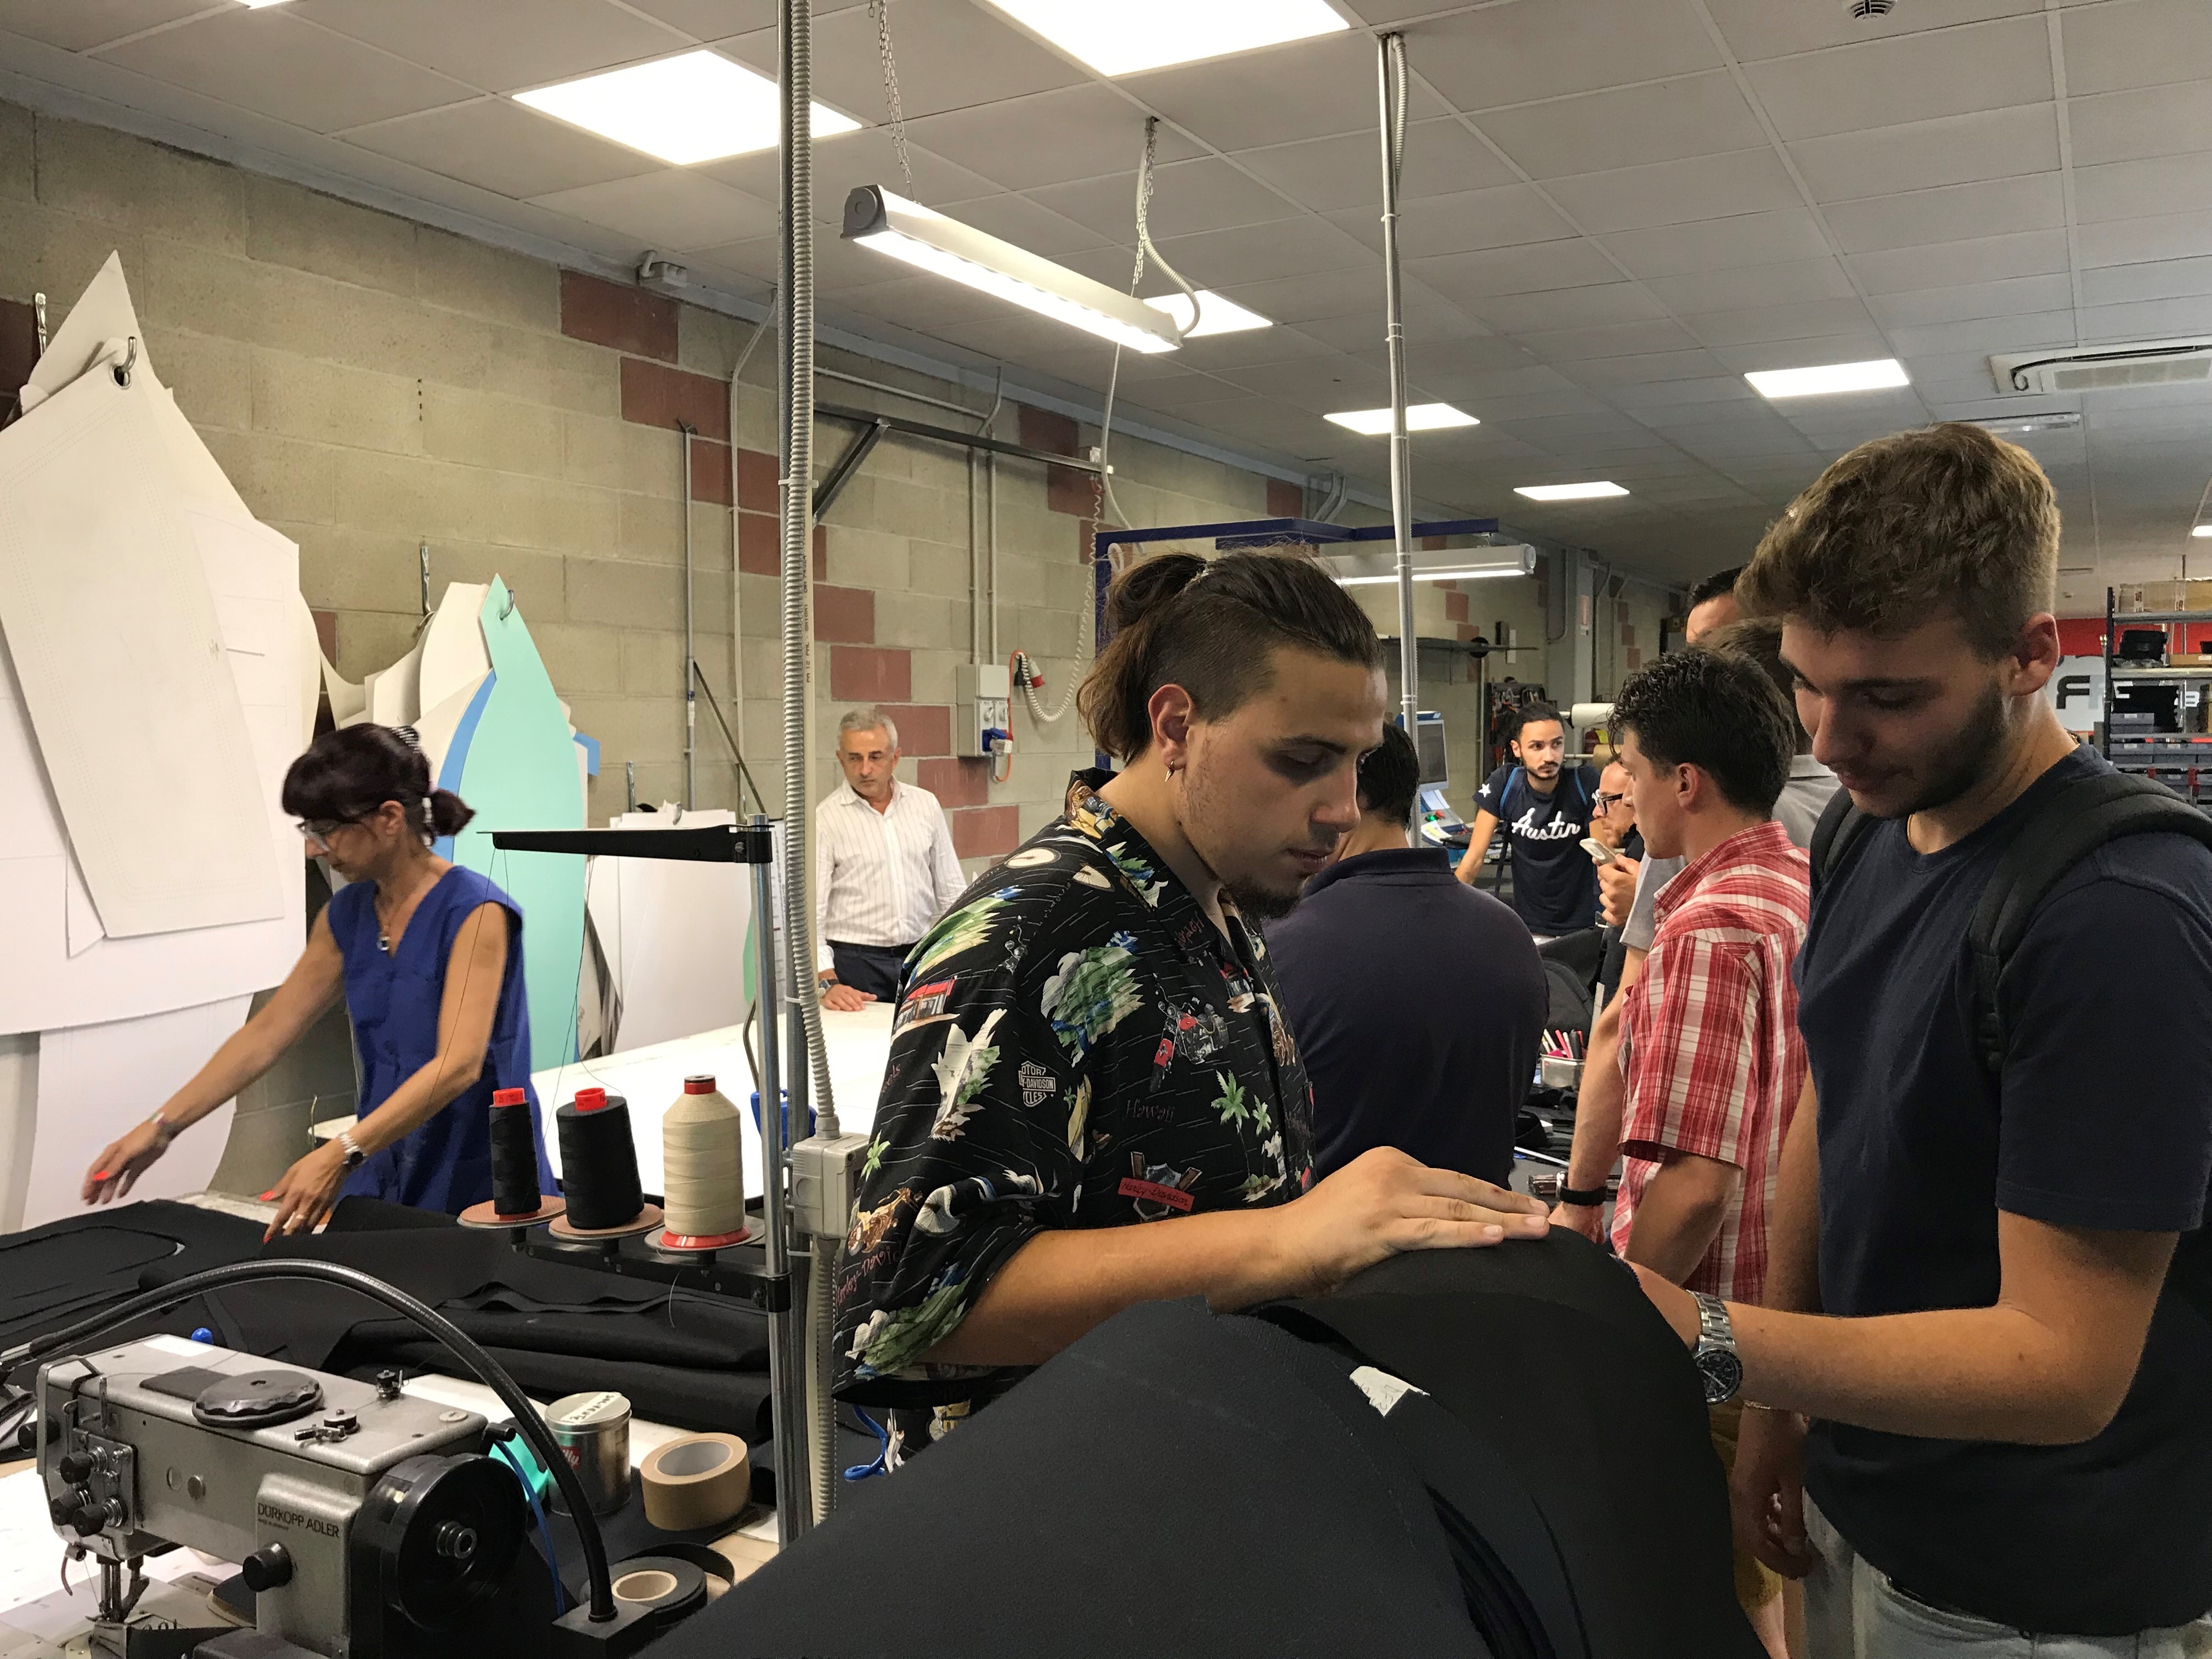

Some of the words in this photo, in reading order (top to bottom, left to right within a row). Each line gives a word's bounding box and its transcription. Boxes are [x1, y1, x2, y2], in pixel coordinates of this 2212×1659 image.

[1511, 807, 1581, 840] Austin
[1126, 1099, 1175, 1122] Hawaii
[305, 1518, 340, 1538] ADLER
